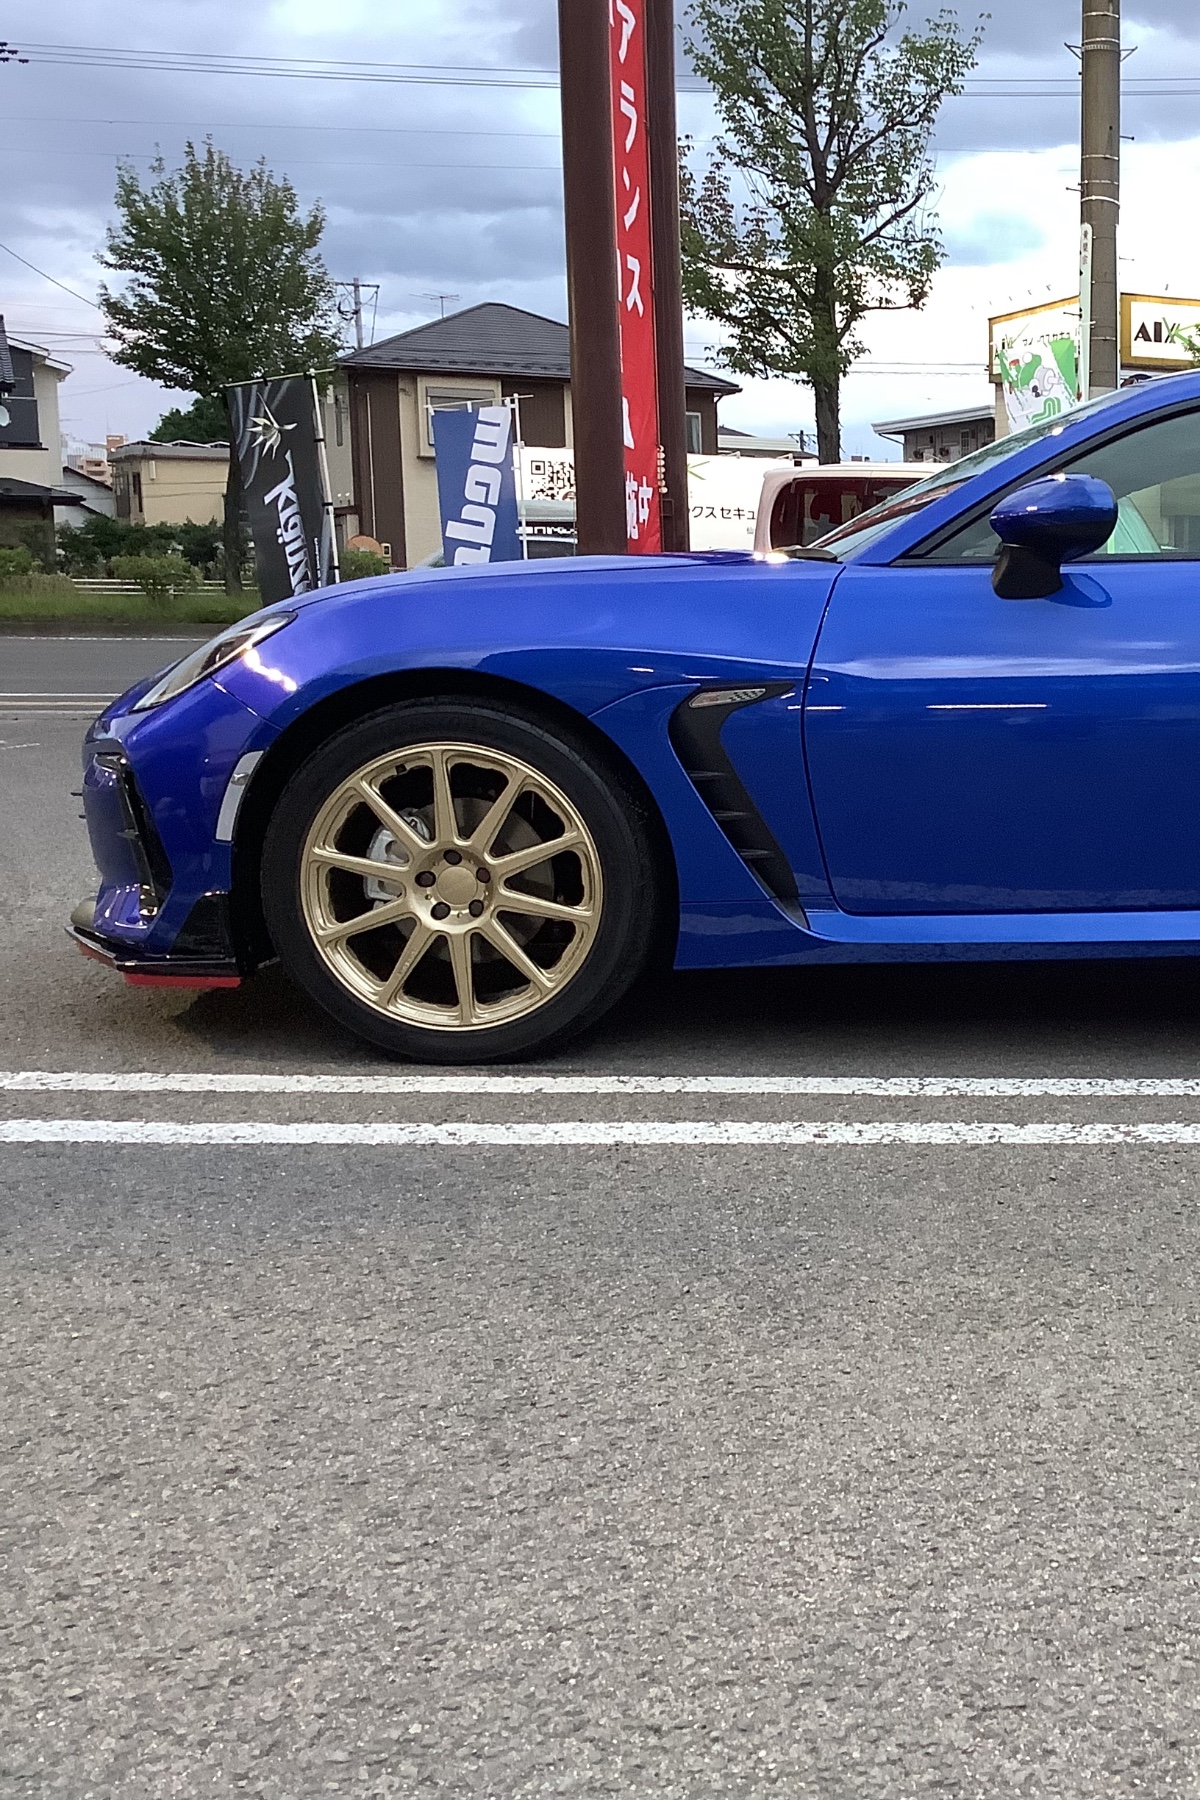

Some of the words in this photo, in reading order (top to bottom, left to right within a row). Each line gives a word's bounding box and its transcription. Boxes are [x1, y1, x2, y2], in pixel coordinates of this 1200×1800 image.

[688, 506, 756, 520] クスセキュ
